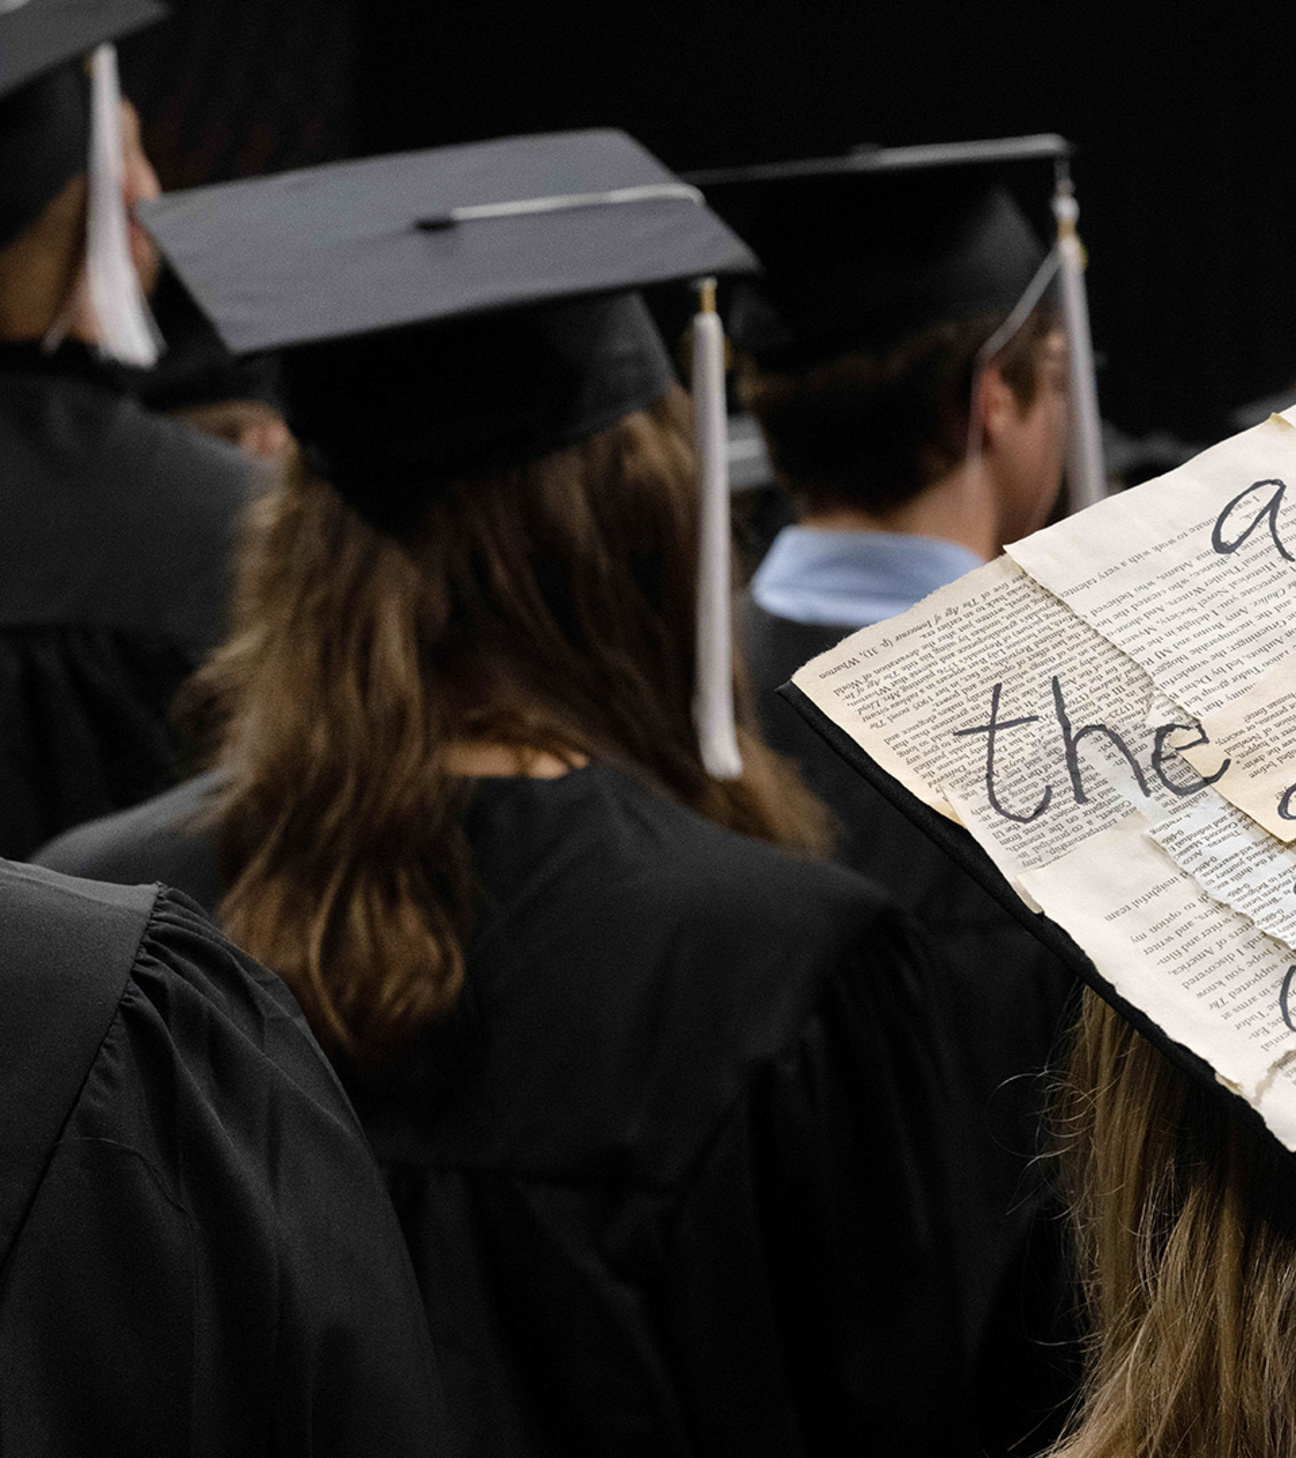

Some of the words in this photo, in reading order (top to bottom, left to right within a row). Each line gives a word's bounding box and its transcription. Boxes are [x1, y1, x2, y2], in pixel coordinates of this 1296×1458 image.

[1151, 538, 1177, 552] work
[1127, 549, 1152, 564] with
[1095, 564, 1120, 579] very
[979, 591, 992, 601] of
[992, 582, 1010, 593] five
[1005, 582, 1031, 597] looks
[974, 605, 987, 613] to
[984, 594, 1008, 608] back
[1272, 598, 1293, 613] and
[962, 610, 975, 618] an
[1223, 605, 1250, 622] Amy
[1254, 609, 1273, 621] the
[936, 616, 964, 633] earlier
[919, 629, 936, 639] era.
[1187, 618, 1256, 656] incomparable
[1171, 636, 1193, 650] and
[1240, 634, 1285, 660] Authors,
[1208, 649, 1228, 661] the
[818, 656, 860, 680] Wharton
[1148, 652, 1190, 678] blogger
[1209, 665, 1227, 677] by
[1224, 658, 1244, 670] led
[1158, 658, 1210, 689] wonderful
[1230, 665, 1263, 684] Tudor
[934, 686, 951, 697] her
[1177, 674, 1212, 694] Debra
[1199, 678, 1230, 696] group
[910, 695, 934, 710] 1905
[1183, 694, 1203, 708] led
[885, 706, 911, 723] novel
[1242, 706, 1268, 723] force?
[1253, 705, 1289, 726] persons,
[1213, 728, 1247, 747] society,
[1260, 726, 1273, 736] of
[954, 674, 1231, 823] the
[1223, 732, 1262, 755] Newland
[1247, 760, 1277, 779] before
[1093, 799, 1132, 821] Colbert,
[1129, 875, 1181, 908] insightful
[1103, 904, 1132, 922] team
[1183, 901, 1197, 912] to
[1147, 909, 1183, 934] option
[1173, 920, 1196, 937] and
[1200, 916, 1233, 939] writer
[1128, 931, 1148, 943] my
[1141, 934, 1175, 956] writer
[1179, 935, 1202, 952] and
[1214, 937, 1229, 950] of
[1155, 948, 1183, 967] film-
[1166, 945, 1215, 977] America,
[1244, 945, 1274, 968] hope
[1181, 952, 1237, 990] discovered
[1222, 964, 1245, 981] you
[1226, 960, 1280, 1000] supported
[1194, 979, 1226, 1000] know
[1257, 987, 1273, 998] in
[1207, 996, 1229, 1011] The
[1231, 995, 1259, 1013] arms
[1220, 1011, 1234, 1021] at
[1233, 1009, 1269, 1031] Tudor
